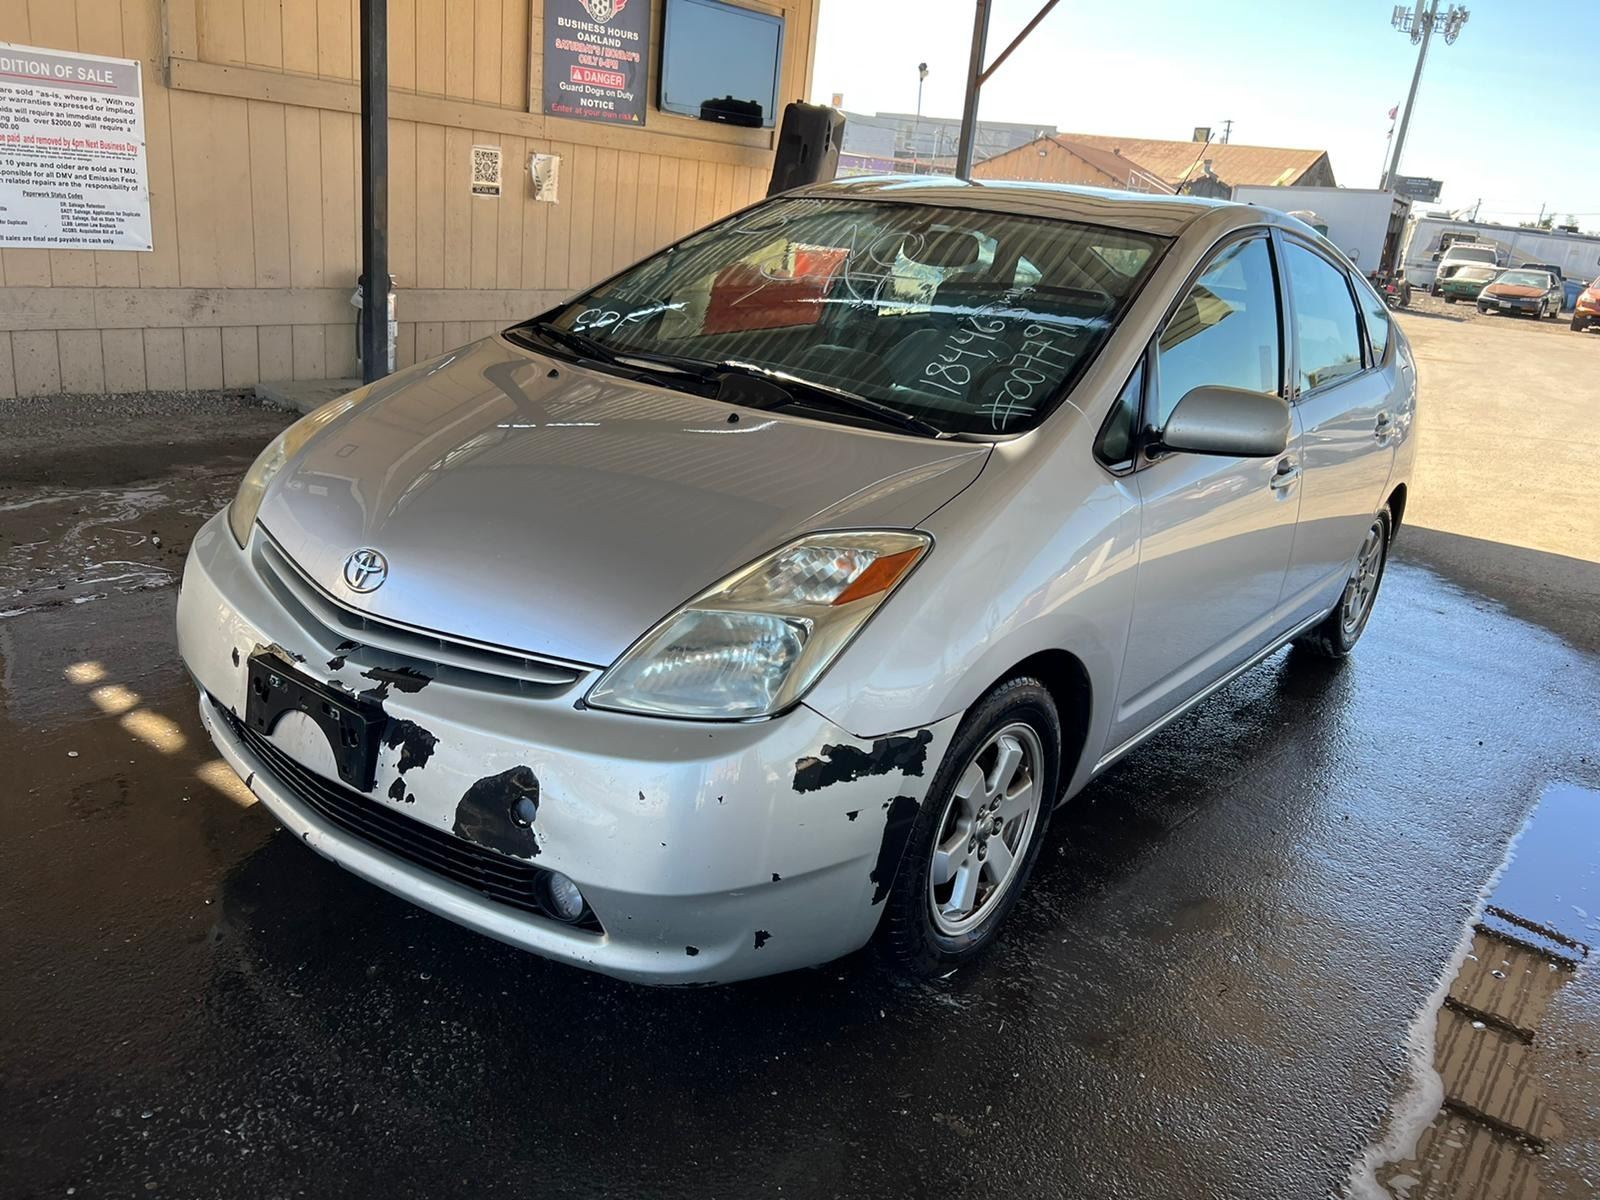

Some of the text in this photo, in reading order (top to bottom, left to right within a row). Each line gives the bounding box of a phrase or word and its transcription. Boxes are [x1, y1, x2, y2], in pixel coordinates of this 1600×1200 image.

[557, 17, 639, 40] BUSINESS HOURS
[577, 32, 621, 47] OAKLAND
[1, 58, 114, 83] DITION OF SALE
[584, 70, 622, 86] DANGER
[64, 94, 88, 102] where
[559, 81, 583, 93] Guard
[585, 85, 604, 97] Dogs
[617, 90, 634, 101] Duty
[8, 97, 51, 106] warranties
[53, 101, 94, 110] expressed
[551, 103, 572, 113] Enter
[575, 106, 583, 114] at
[584, 108, 600, 117] your
[602, 111, 618, 119] own
[580, 98, 615, 110] NOTICE
[14, 115, 30, 123] bids
[51, 118, 81, 128] $2000.00
[29, 109, 54, 117] require
[66, 112, 101, 121] immediate
[103, 116, 128, 124] deposit
[36, 136, 61, 146] removed
[100, 140, 126, 151] Business
[126, 142, 138, 154] Day
[56, 171, 73, 179] DMV
[88, 174, 120, 182] Emission
[32, 179, 56, 187] repairs
[85, 183, 130, 191] responsibility
[22, 190, 49, 198] Paperwork
